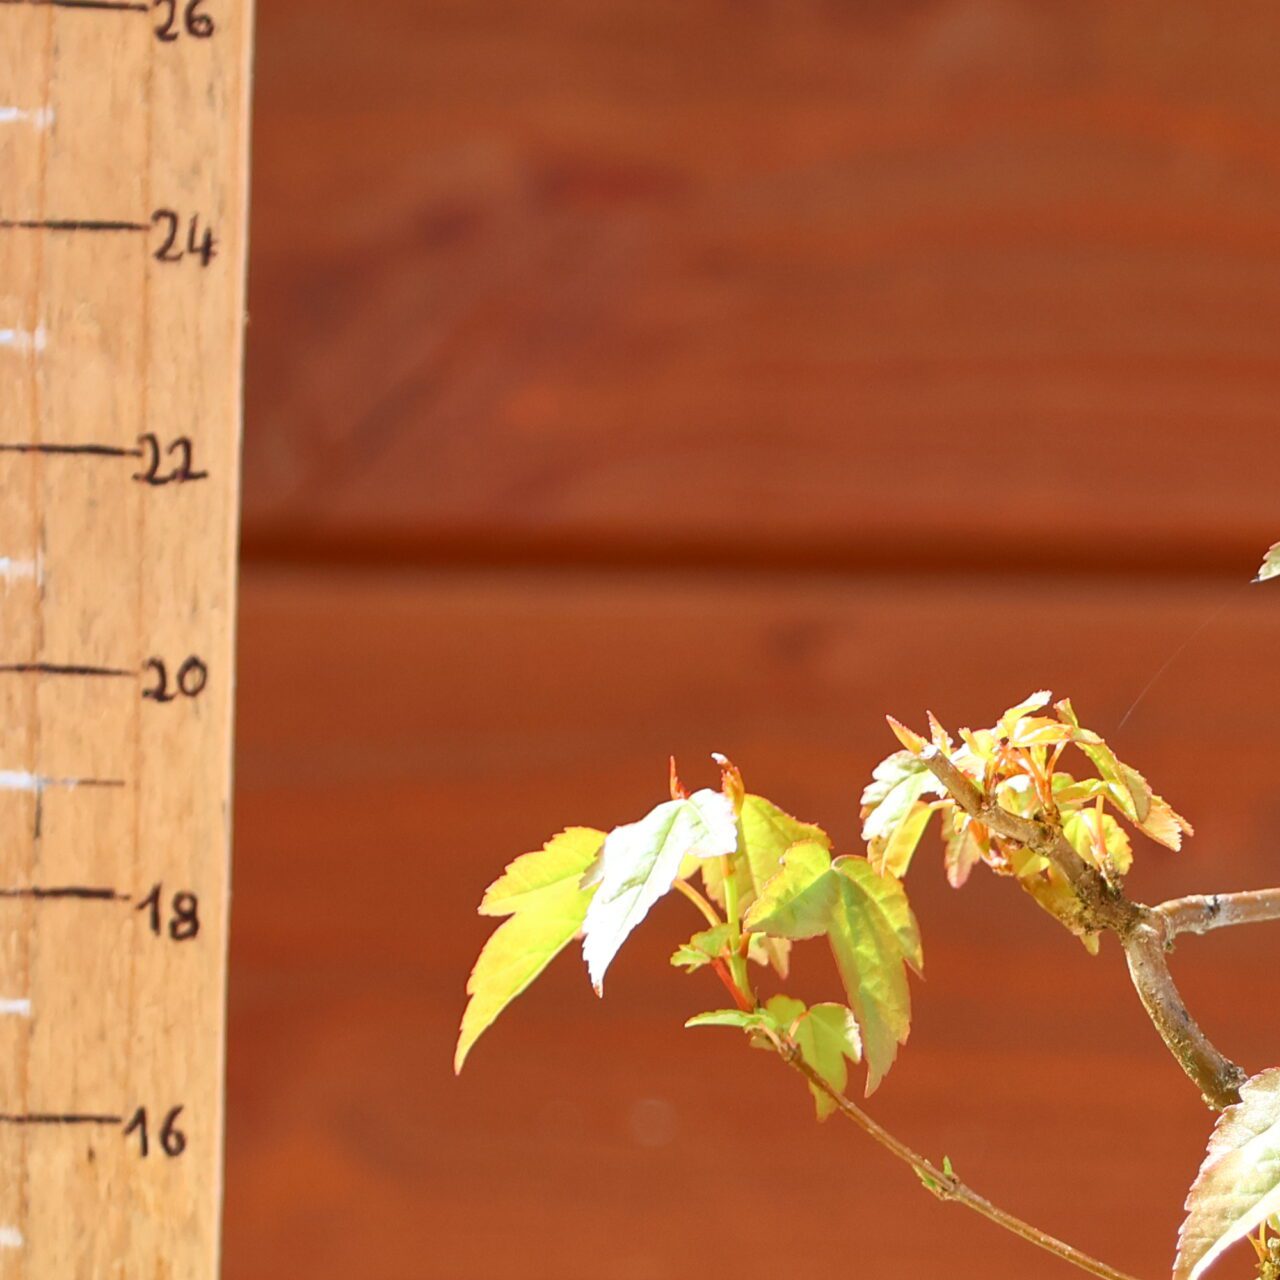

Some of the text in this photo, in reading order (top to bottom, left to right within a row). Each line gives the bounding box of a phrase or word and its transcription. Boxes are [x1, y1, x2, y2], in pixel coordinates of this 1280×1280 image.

[154, 0, 215, 42] 26
[151, 208, 218, 268] 24
[132, 432, 209, 485] 22
[142, 654, 208, 702] 20
[135, 881, 200, 941] 18
[123, 1105, 187, 1157] 16
